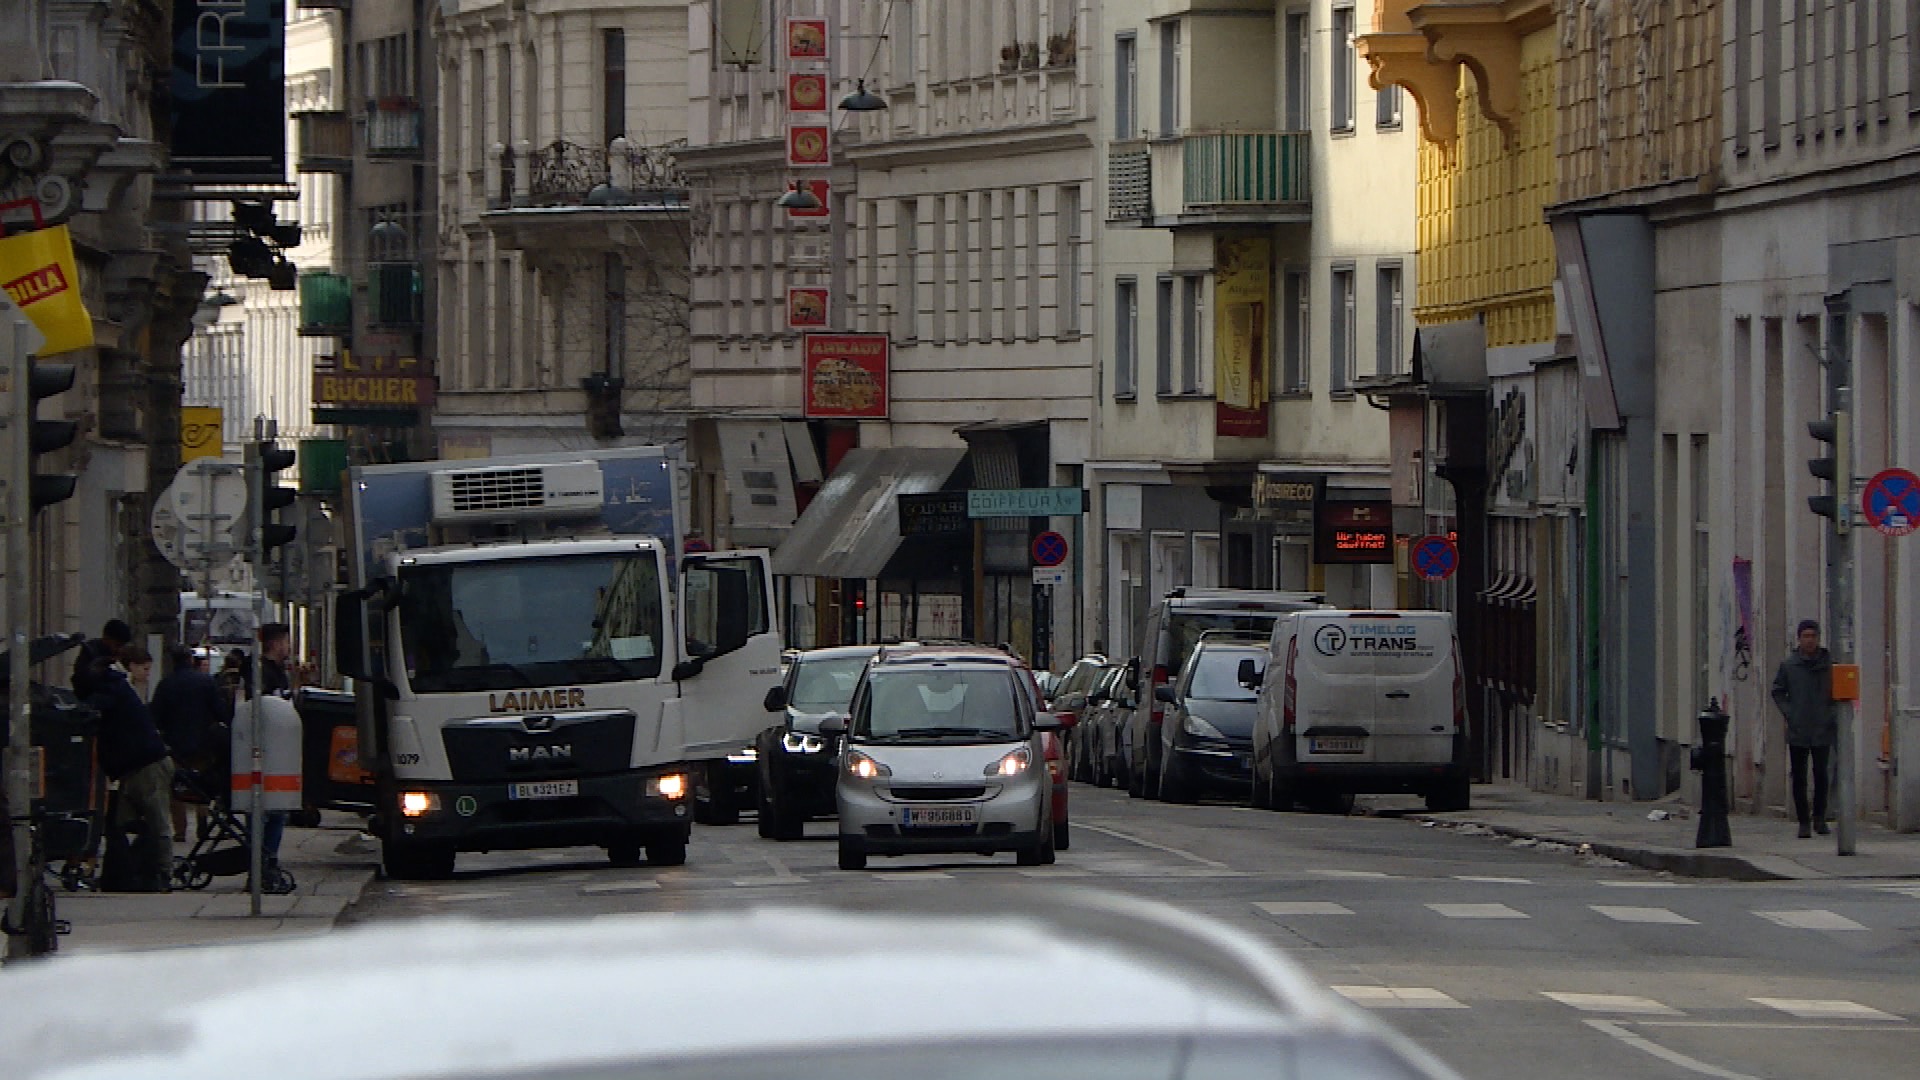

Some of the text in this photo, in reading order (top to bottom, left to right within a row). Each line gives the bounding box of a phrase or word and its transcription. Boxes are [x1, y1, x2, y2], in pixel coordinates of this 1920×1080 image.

[196, 0, 246, 88] FR
[322, 377, 417, 403] BÜCHER
[1350, 624, 1416, 635] TIMELOG
[1350, 637, 1416, 651] TRANS
[489, 688, 585, 713] LAIMER
[509, 743, 571, 760] MAN
